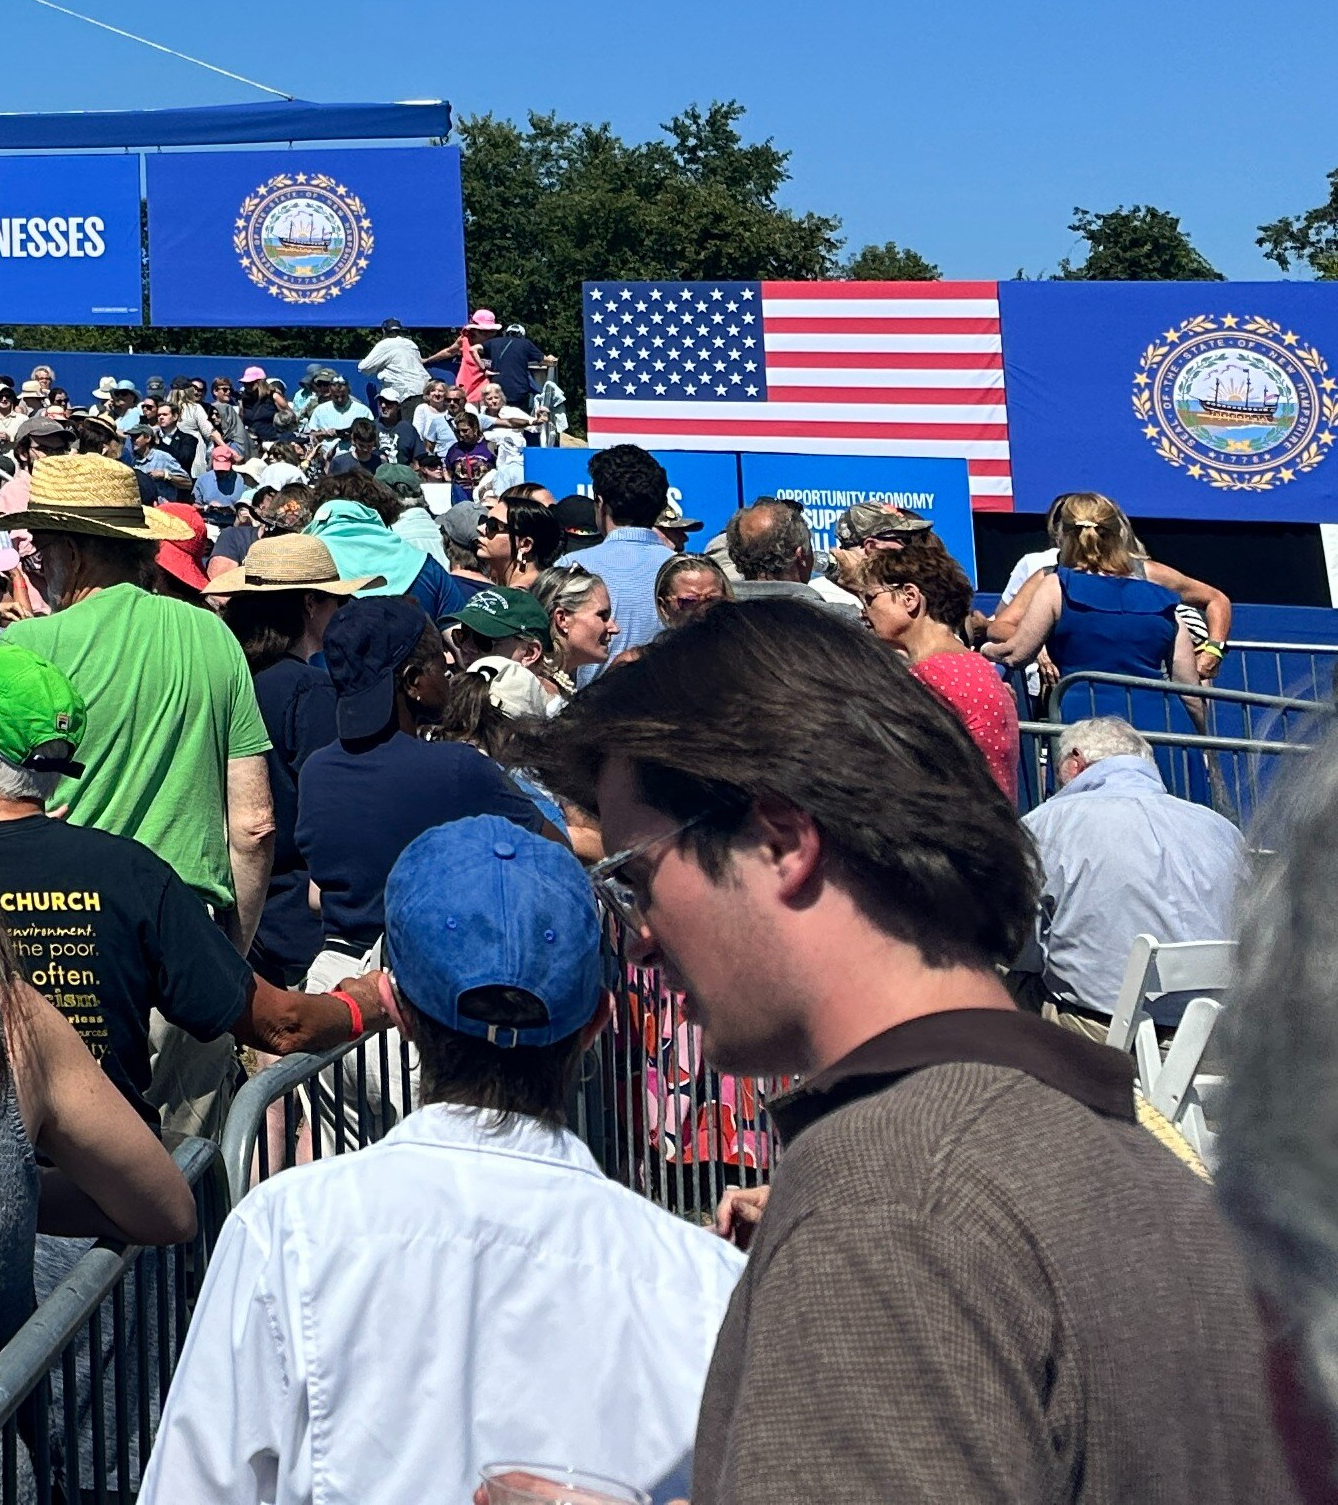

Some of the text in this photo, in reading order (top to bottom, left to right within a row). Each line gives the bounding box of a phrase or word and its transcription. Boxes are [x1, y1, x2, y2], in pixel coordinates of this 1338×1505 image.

[1162, 339, 1311, 450] SEAL OF THE STATE OF NEW HAMPSHIRE
[776, 489, 935, 509] OPPORTUNITY ECONOMY
[0, 891, 101, 912] CHURCH
[49, 942, 100, 959] poor.
[31, 961, 101, 986] often.
